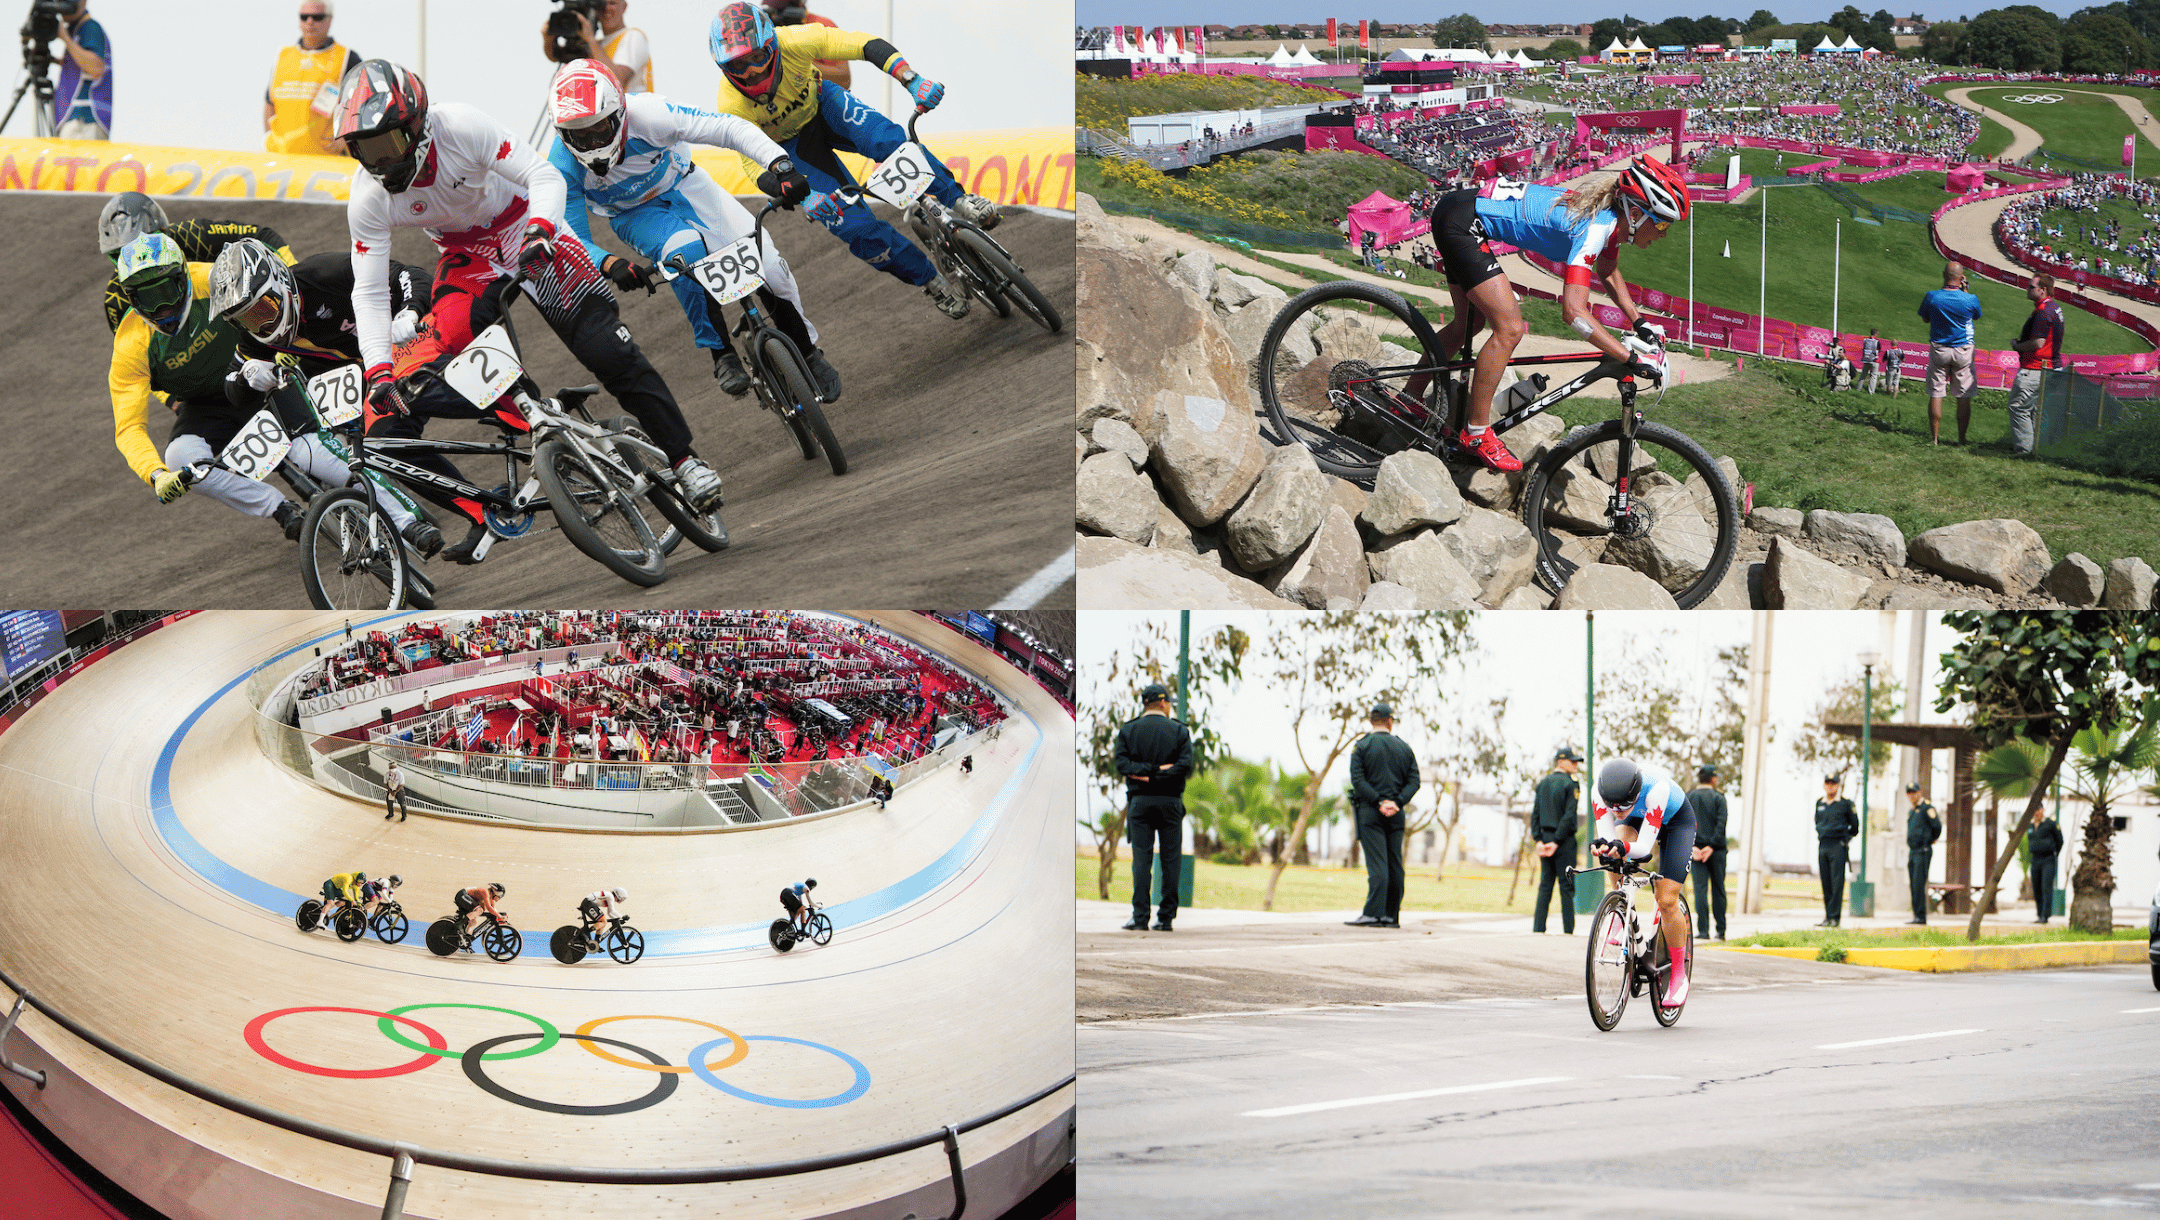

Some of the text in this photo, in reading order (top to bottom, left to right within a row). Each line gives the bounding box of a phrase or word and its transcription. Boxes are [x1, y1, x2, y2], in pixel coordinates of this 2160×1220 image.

[164, 161, 353, 201] 2015
[881, 156, 921, 195] 50
[703, 244, 760, 293] 595
[165, 327, 218, 370] BRASIL
[1686, 328, 1709, 338] Lndon
[469, 349, 500, 384] 2
[314, 372, 360, 414] 278
[1499, 375, 1587, 427] TREK
[229, 418, 283, 475] 500
[369, 453, 481, 497] CHASE
